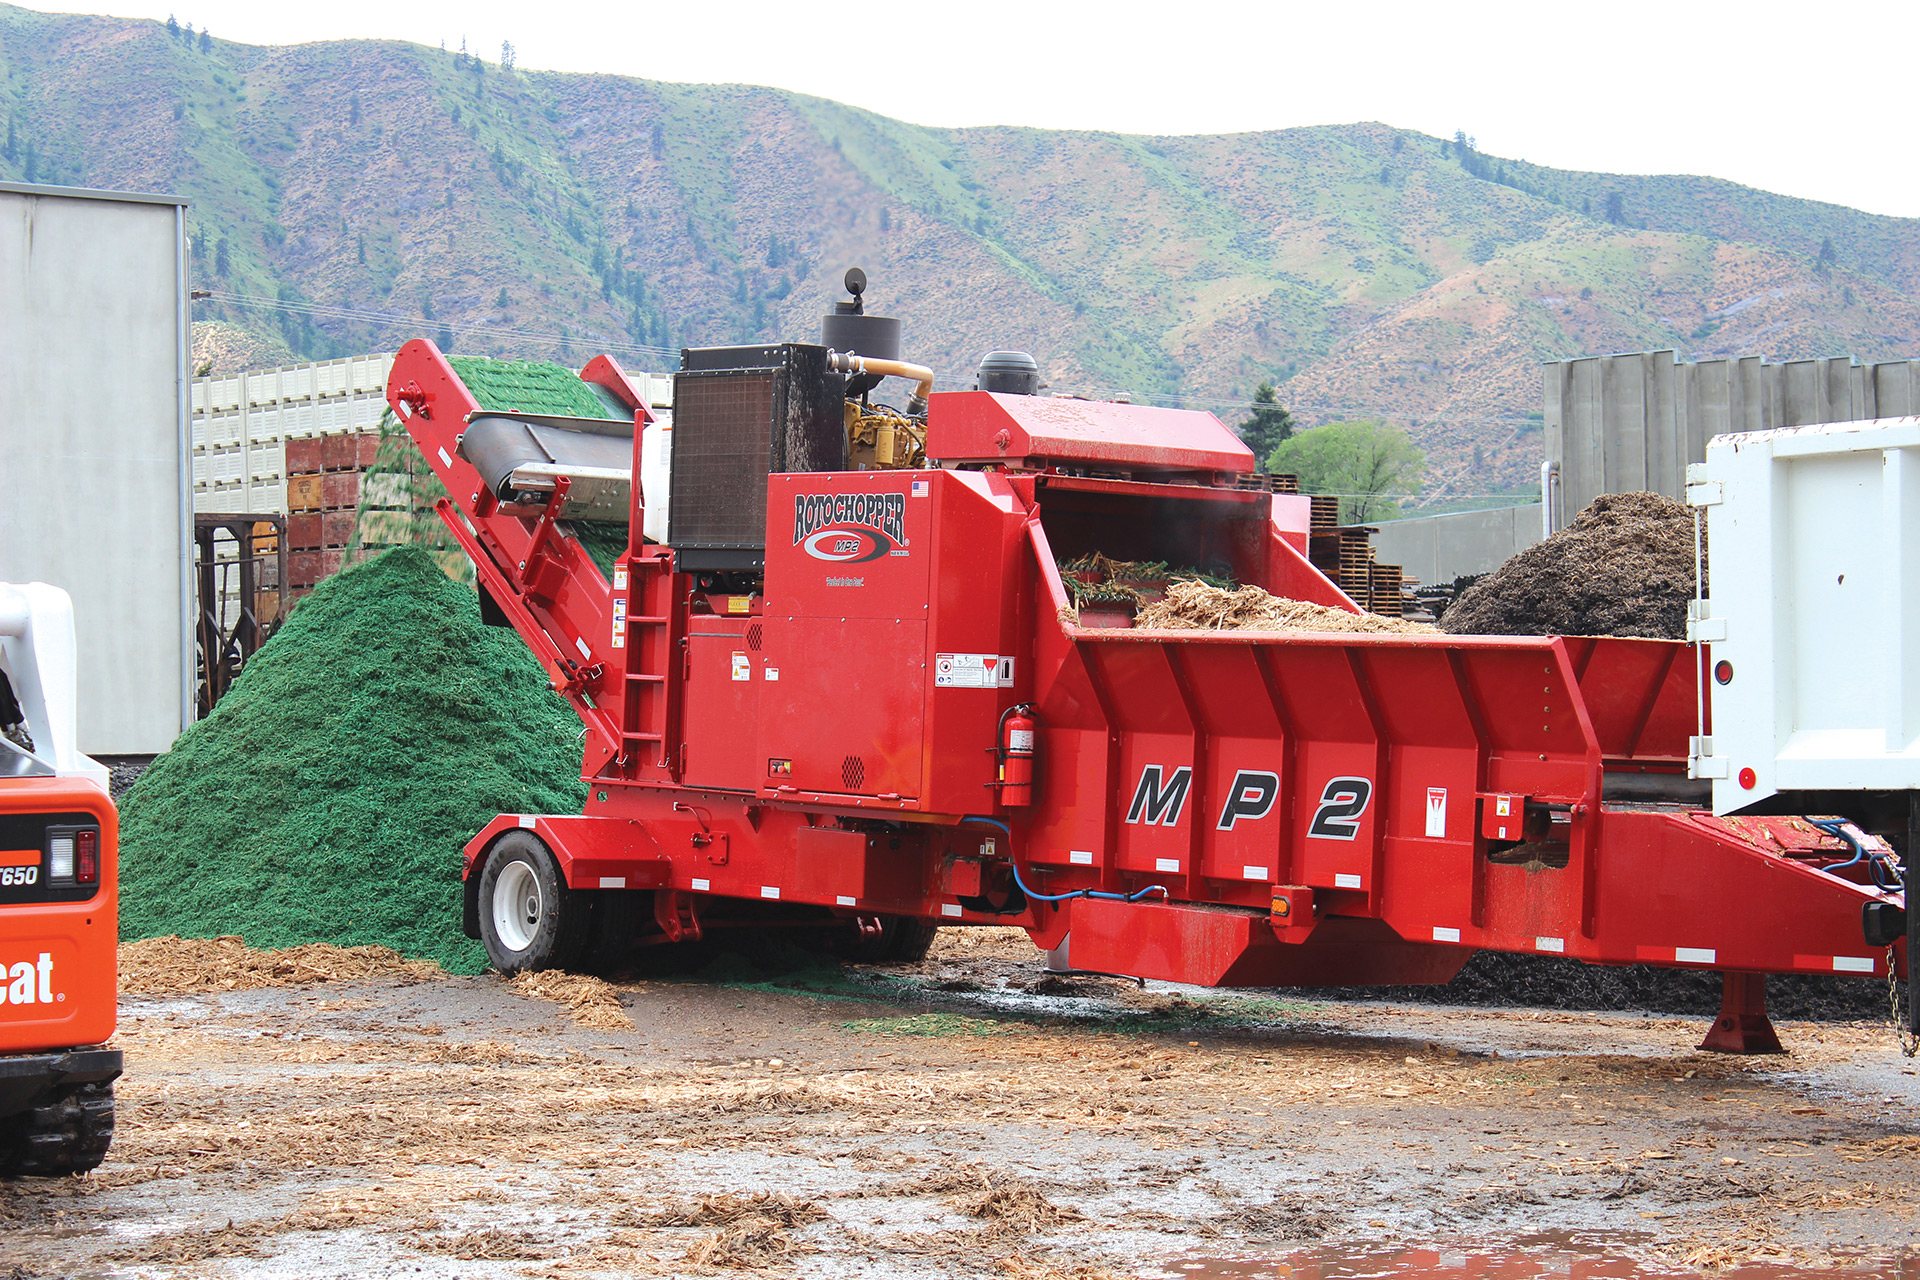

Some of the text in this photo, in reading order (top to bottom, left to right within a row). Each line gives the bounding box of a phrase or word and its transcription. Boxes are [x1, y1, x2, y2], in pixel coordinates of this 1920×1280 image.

[793, 493, 905, 547] ROTOCHOPPER
[833, 539, 860, 553] MP2
[0, 866, 38, 886] 650
